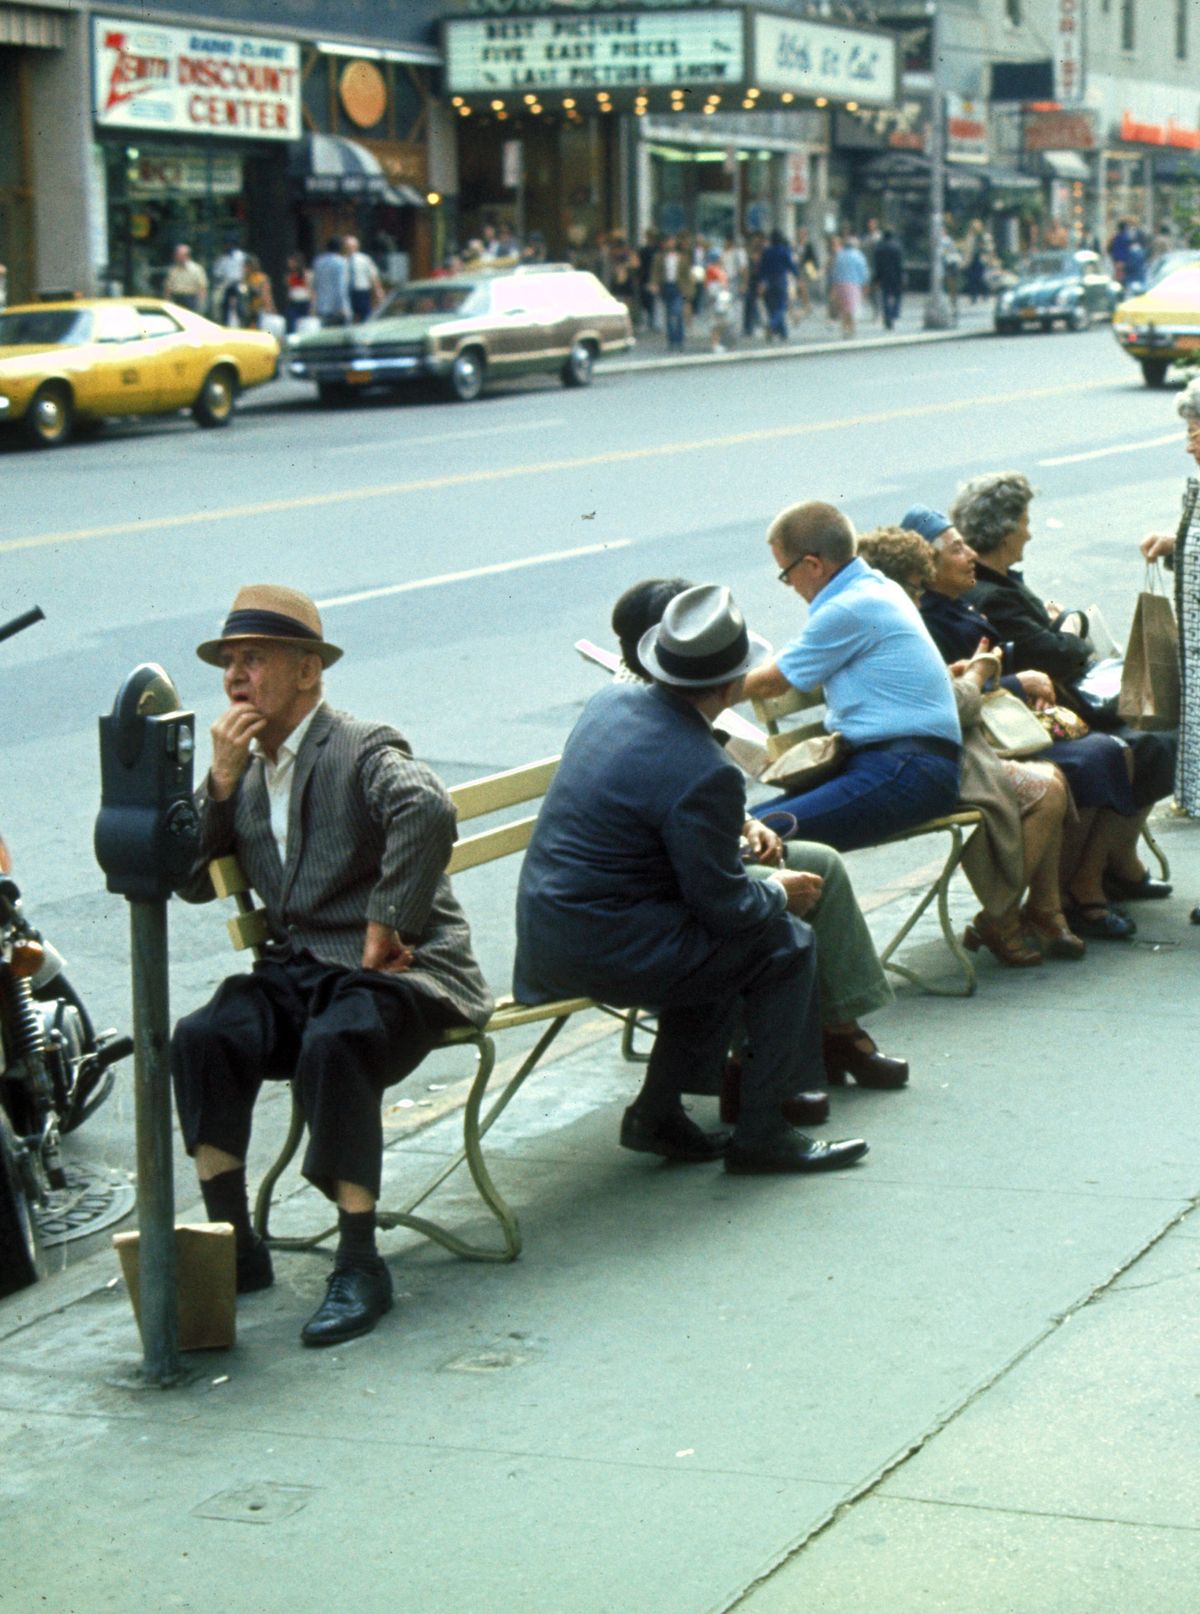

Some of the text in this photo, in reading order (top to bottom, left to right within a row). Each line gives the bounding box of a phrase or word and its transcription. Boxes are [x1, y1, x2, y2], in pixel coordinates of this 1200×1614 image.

[553, 17, 638, 36] PICTURE
[482, 40, 680, 62] FIVE EASY PIECES
[177, 54, 296, 94] DISCOUNT
[569, 64, 652, 82] PICTURE
[674, 61, 728, 78] SHOW
[188, 93, 288, 129] CENTER
